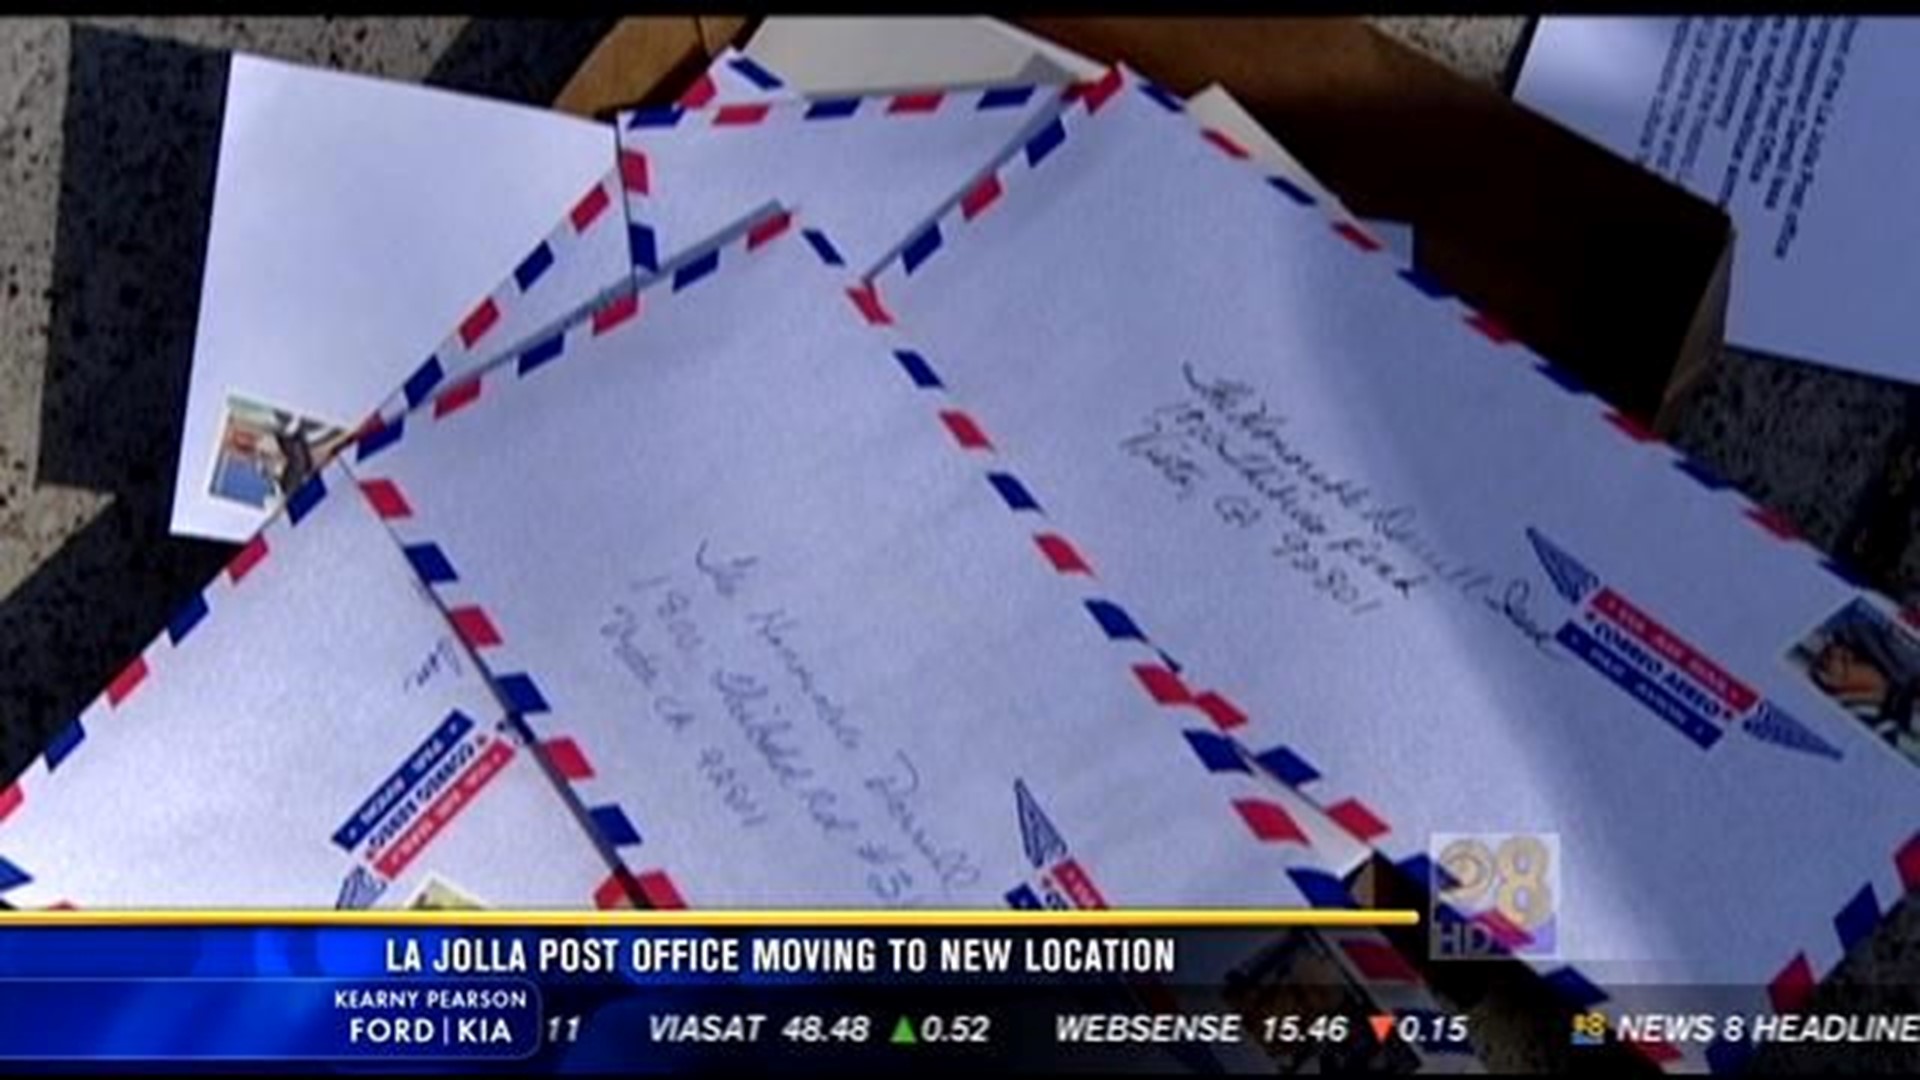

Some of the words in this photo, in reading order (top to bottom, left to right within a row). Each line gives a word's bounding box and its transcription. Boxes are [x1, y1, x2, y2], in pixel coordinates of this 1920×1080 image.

[1765, 93, 1787, 131] Post
[1814, 105, 1832, 128] La
[1749, 133, 1775, 185] Office
[1802, 128, 1824, 169] Jolla
[1790, 170, 1812, 208] Post
